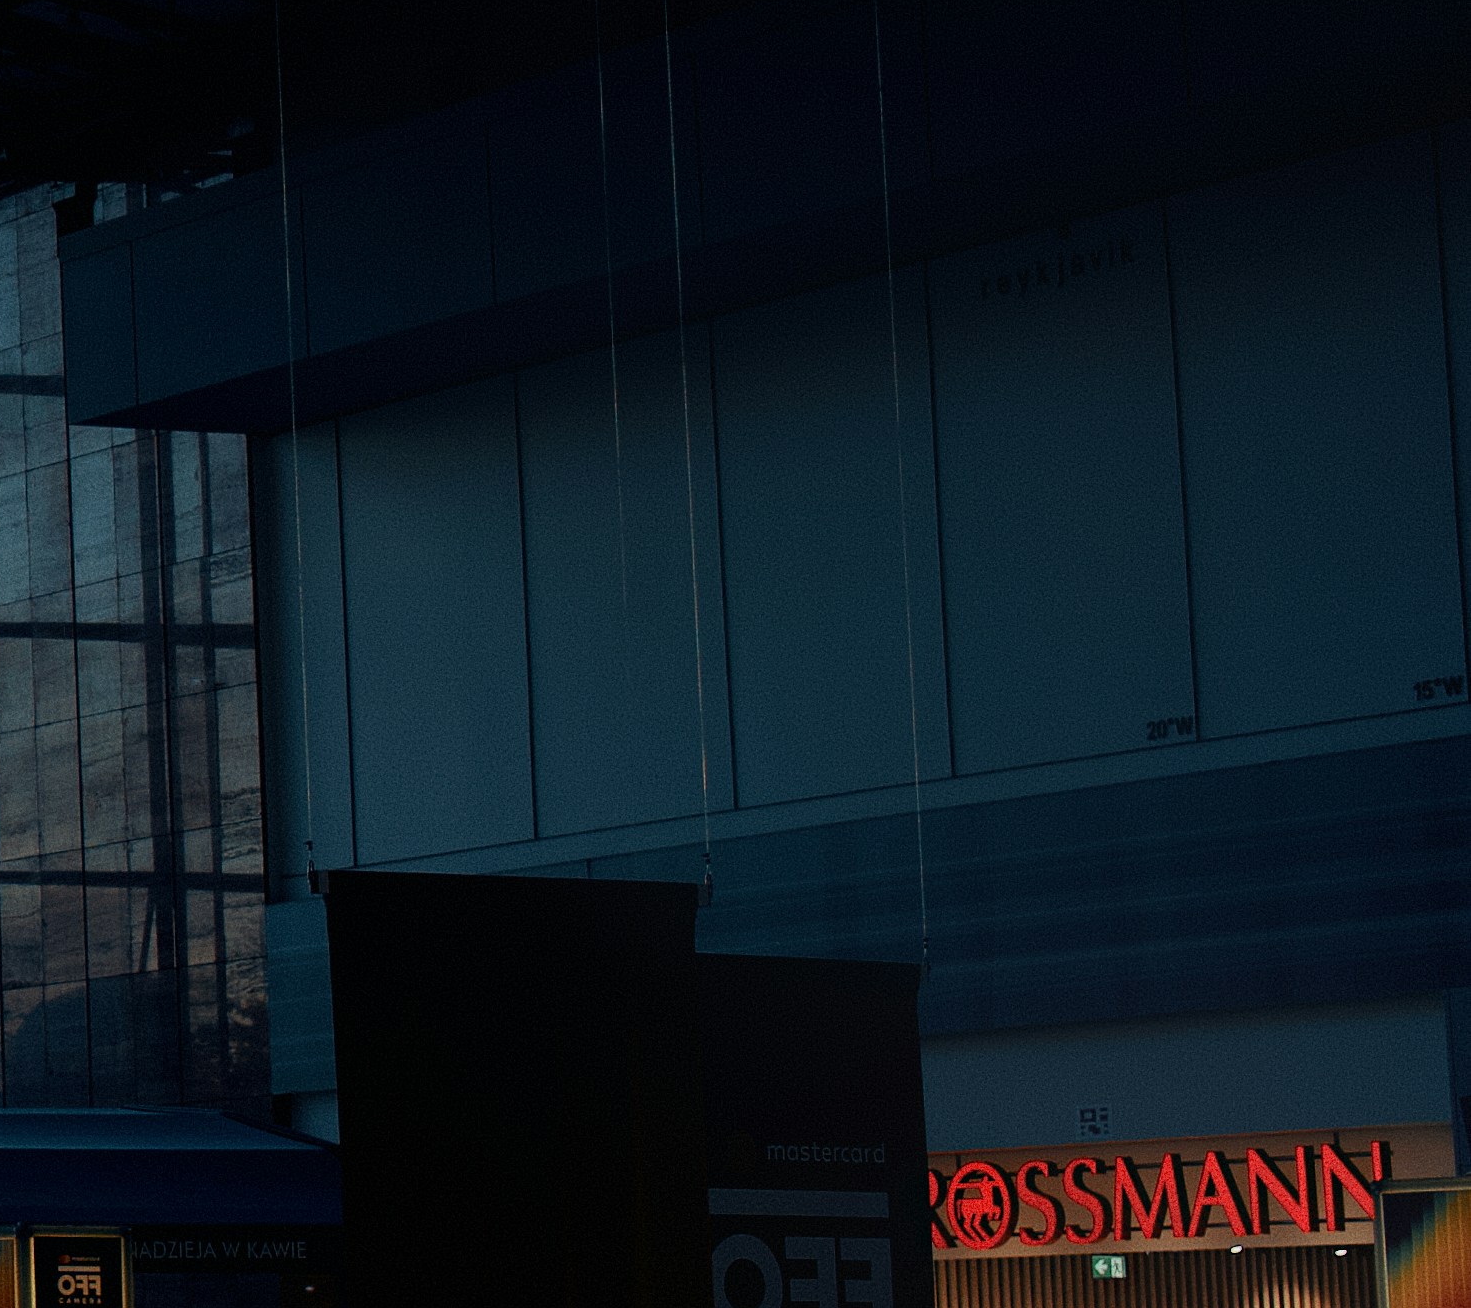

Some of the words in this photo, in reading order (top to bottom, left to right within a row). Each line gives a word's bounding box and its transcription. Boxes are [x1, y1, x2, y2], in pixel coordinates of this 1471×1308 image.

[767, 1143, 886, 1163] mastercard
[222, 1241, 240, 1260] W
[247, 1241, 307, 1260] KAWIE
[56, 1274, 103, 1297] OFF
